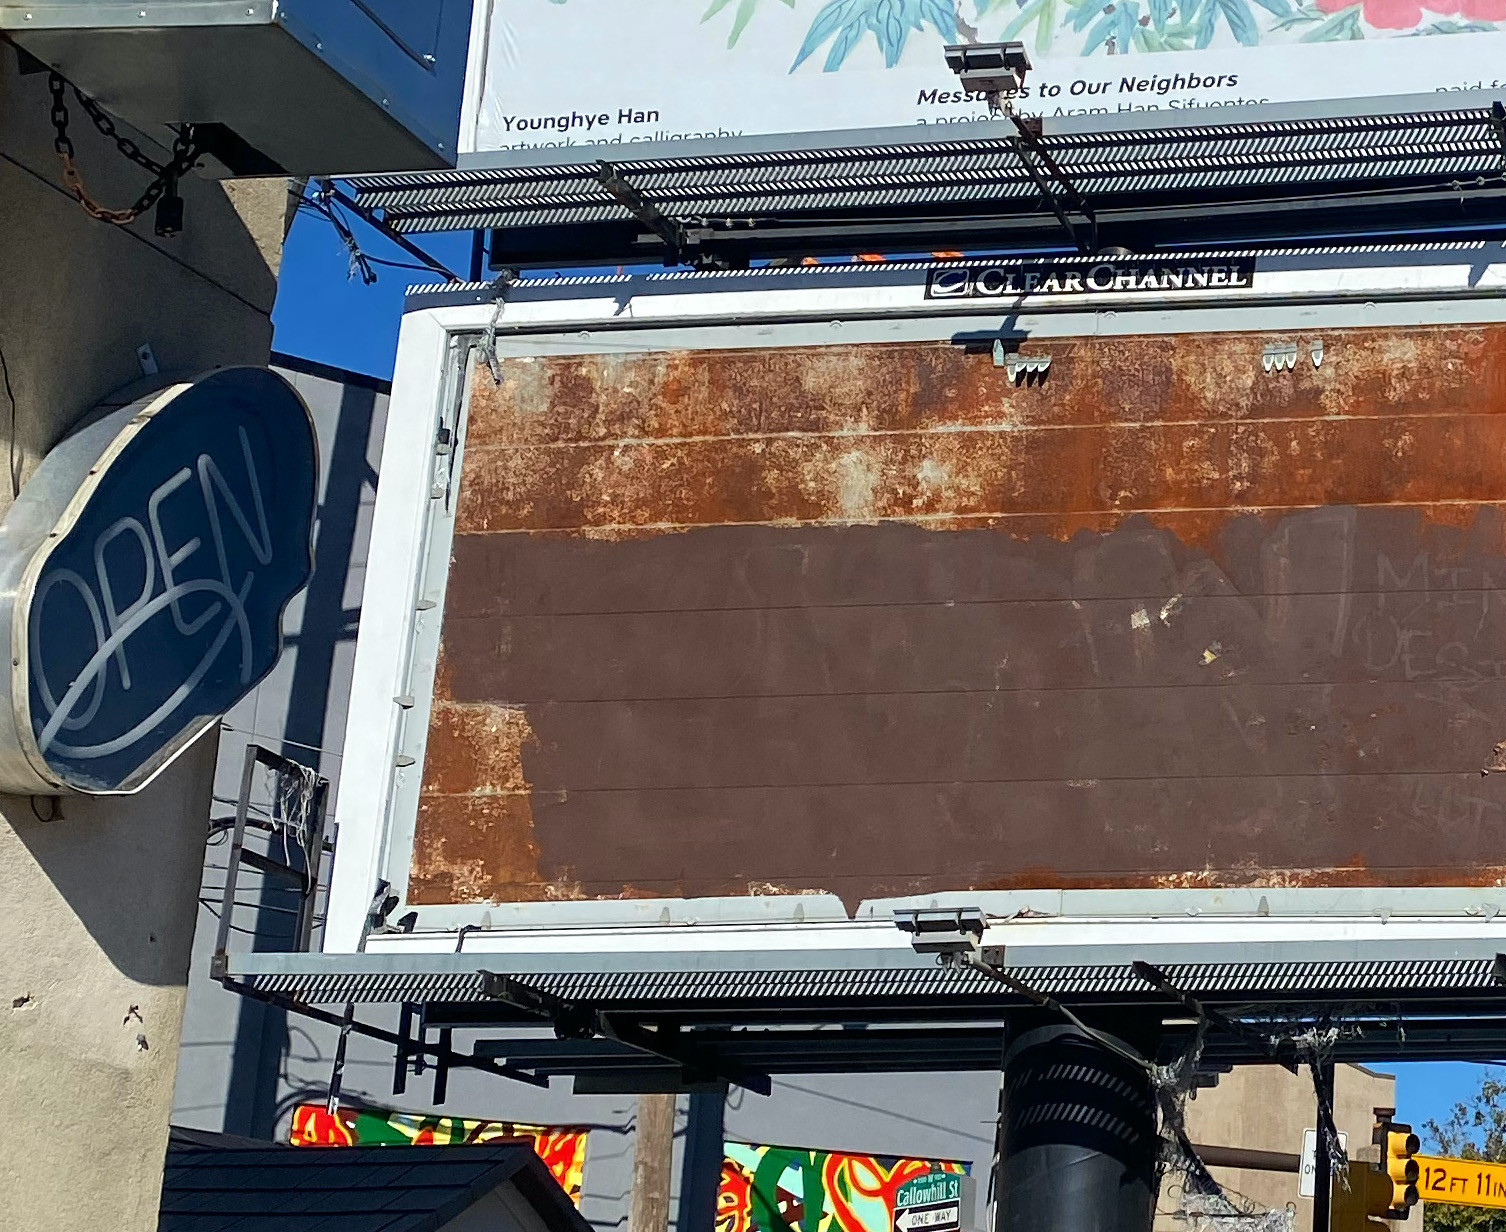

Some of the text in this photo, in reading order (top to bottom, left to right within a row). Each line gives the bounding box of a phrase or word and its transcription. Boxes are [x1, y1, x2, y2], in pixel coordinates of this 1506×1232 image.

[916, 71, 1239, 106] Messaes to Our Neighbors
[502, 108, 660, 133] Younghye Han
[629, 126, 743, 144] callirah
[30, 424, 273, 732] OPEN
[897, 1179, 959, 1206] Callowhill St
[911, 1209, 952, 1226] ONE WAY
